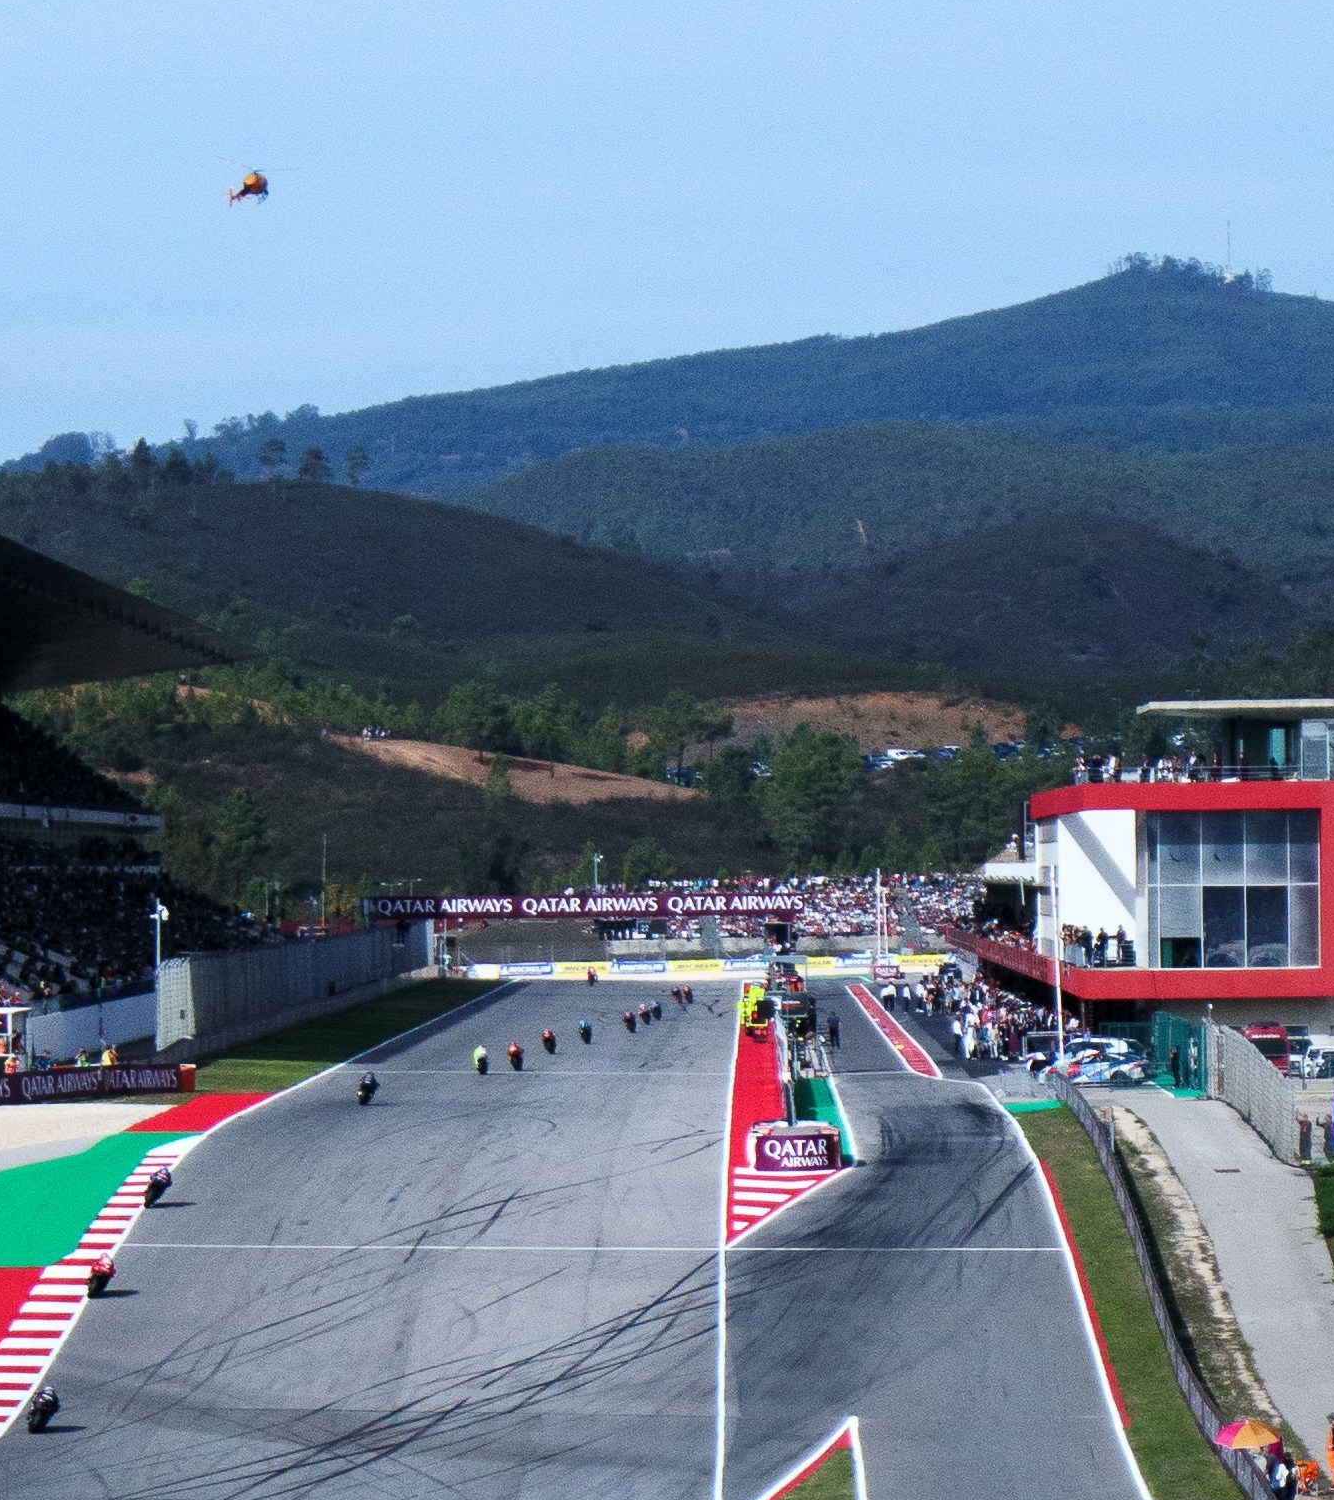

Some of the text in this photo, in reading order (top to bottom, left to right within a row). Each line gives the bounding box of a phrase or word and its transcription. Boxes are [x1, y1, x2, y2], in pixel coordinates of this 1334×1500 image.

[378, 895, 804, 915] QATAR AIRWAYS QATAR AIRWAYS QATAR AIRWAYS
[22, 1071, 99, 1100] QATAR AIRWAYS
[764, 1139, 827, 1157] QATAR
[781, 1155, 829, 1167] AIRWAYS
